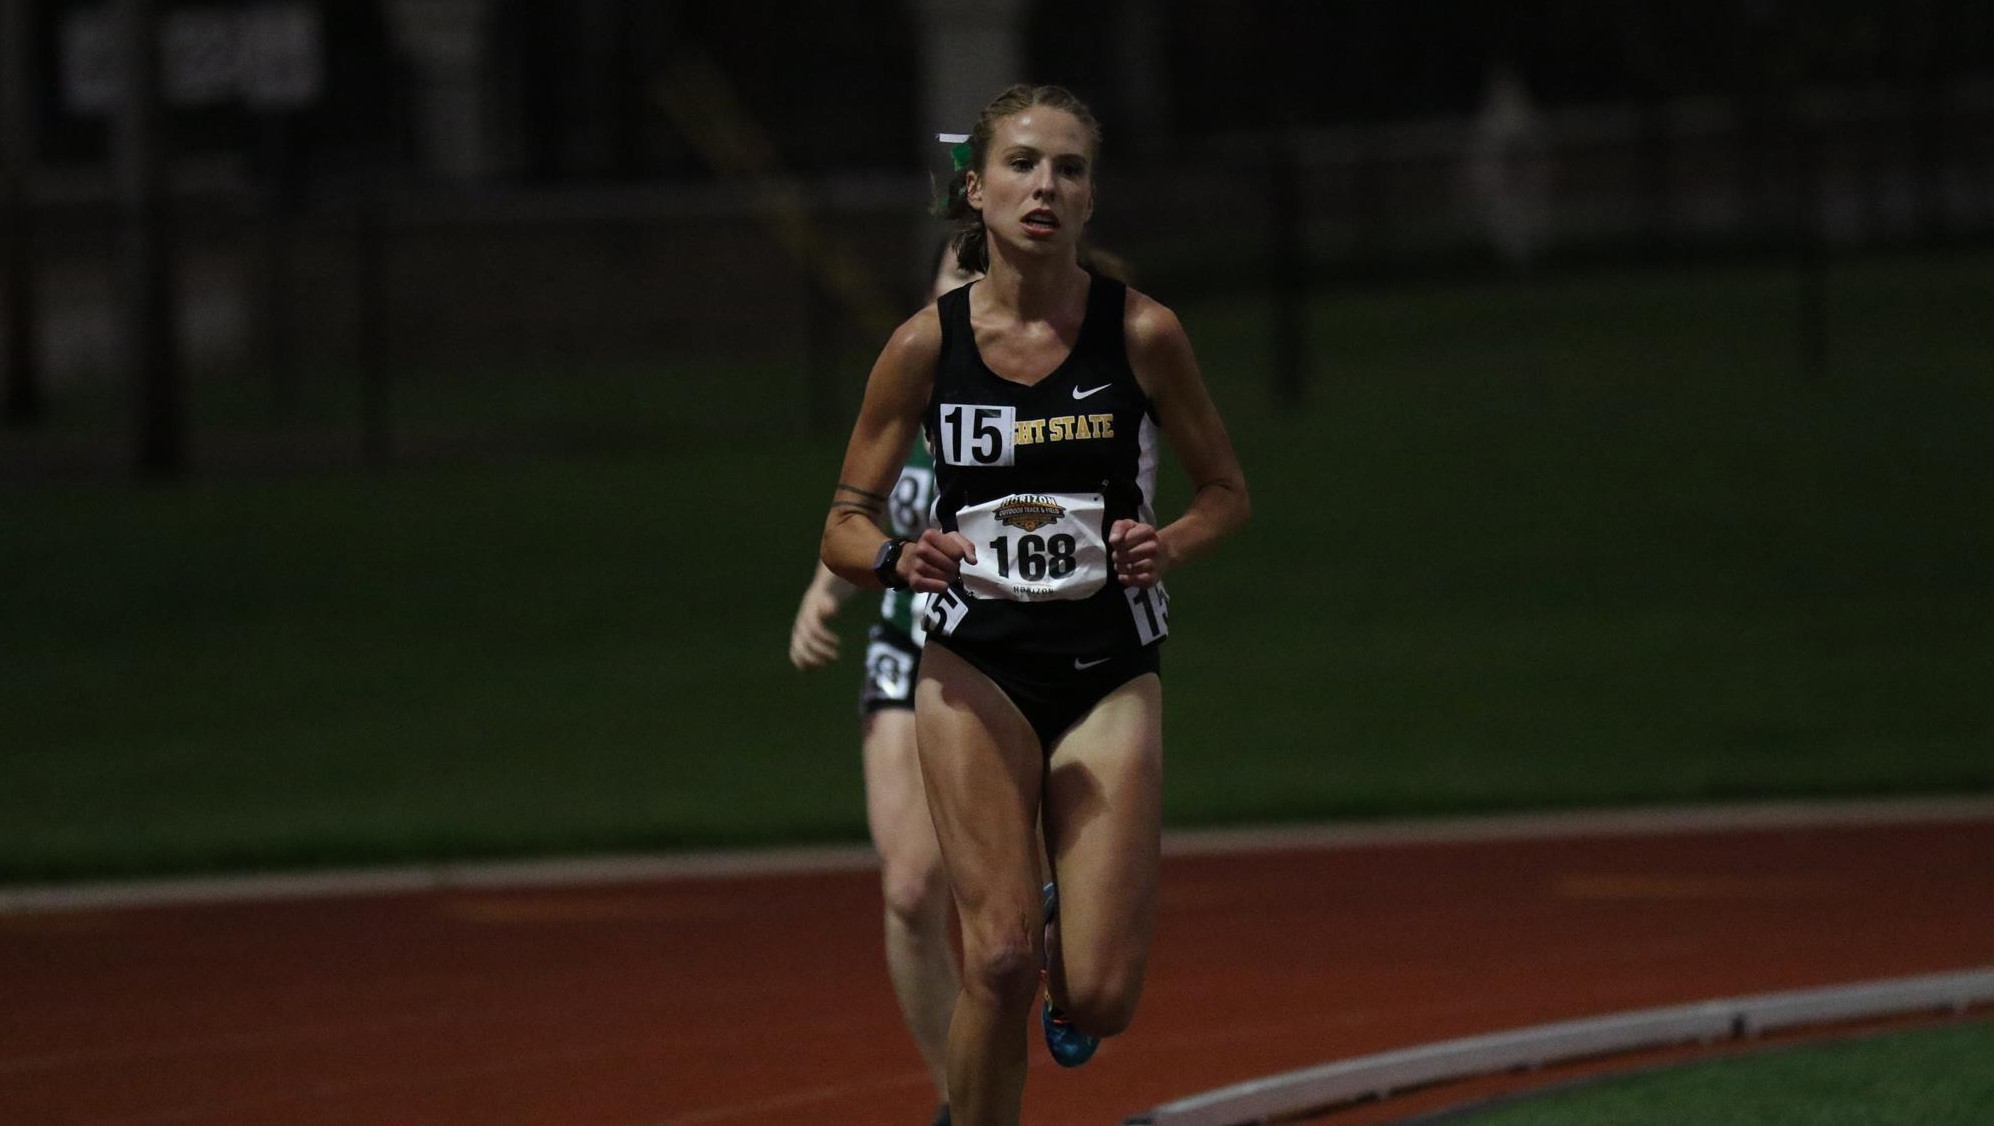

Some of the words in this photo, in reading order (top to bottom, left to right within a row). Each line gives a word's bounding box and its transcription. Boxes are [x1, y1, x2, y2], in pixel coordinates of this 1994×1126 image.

[944, 406, 1003, 464] 15
[1049, 413, 1115, 442] STATE
[990, 533, 1077, 582] 168
